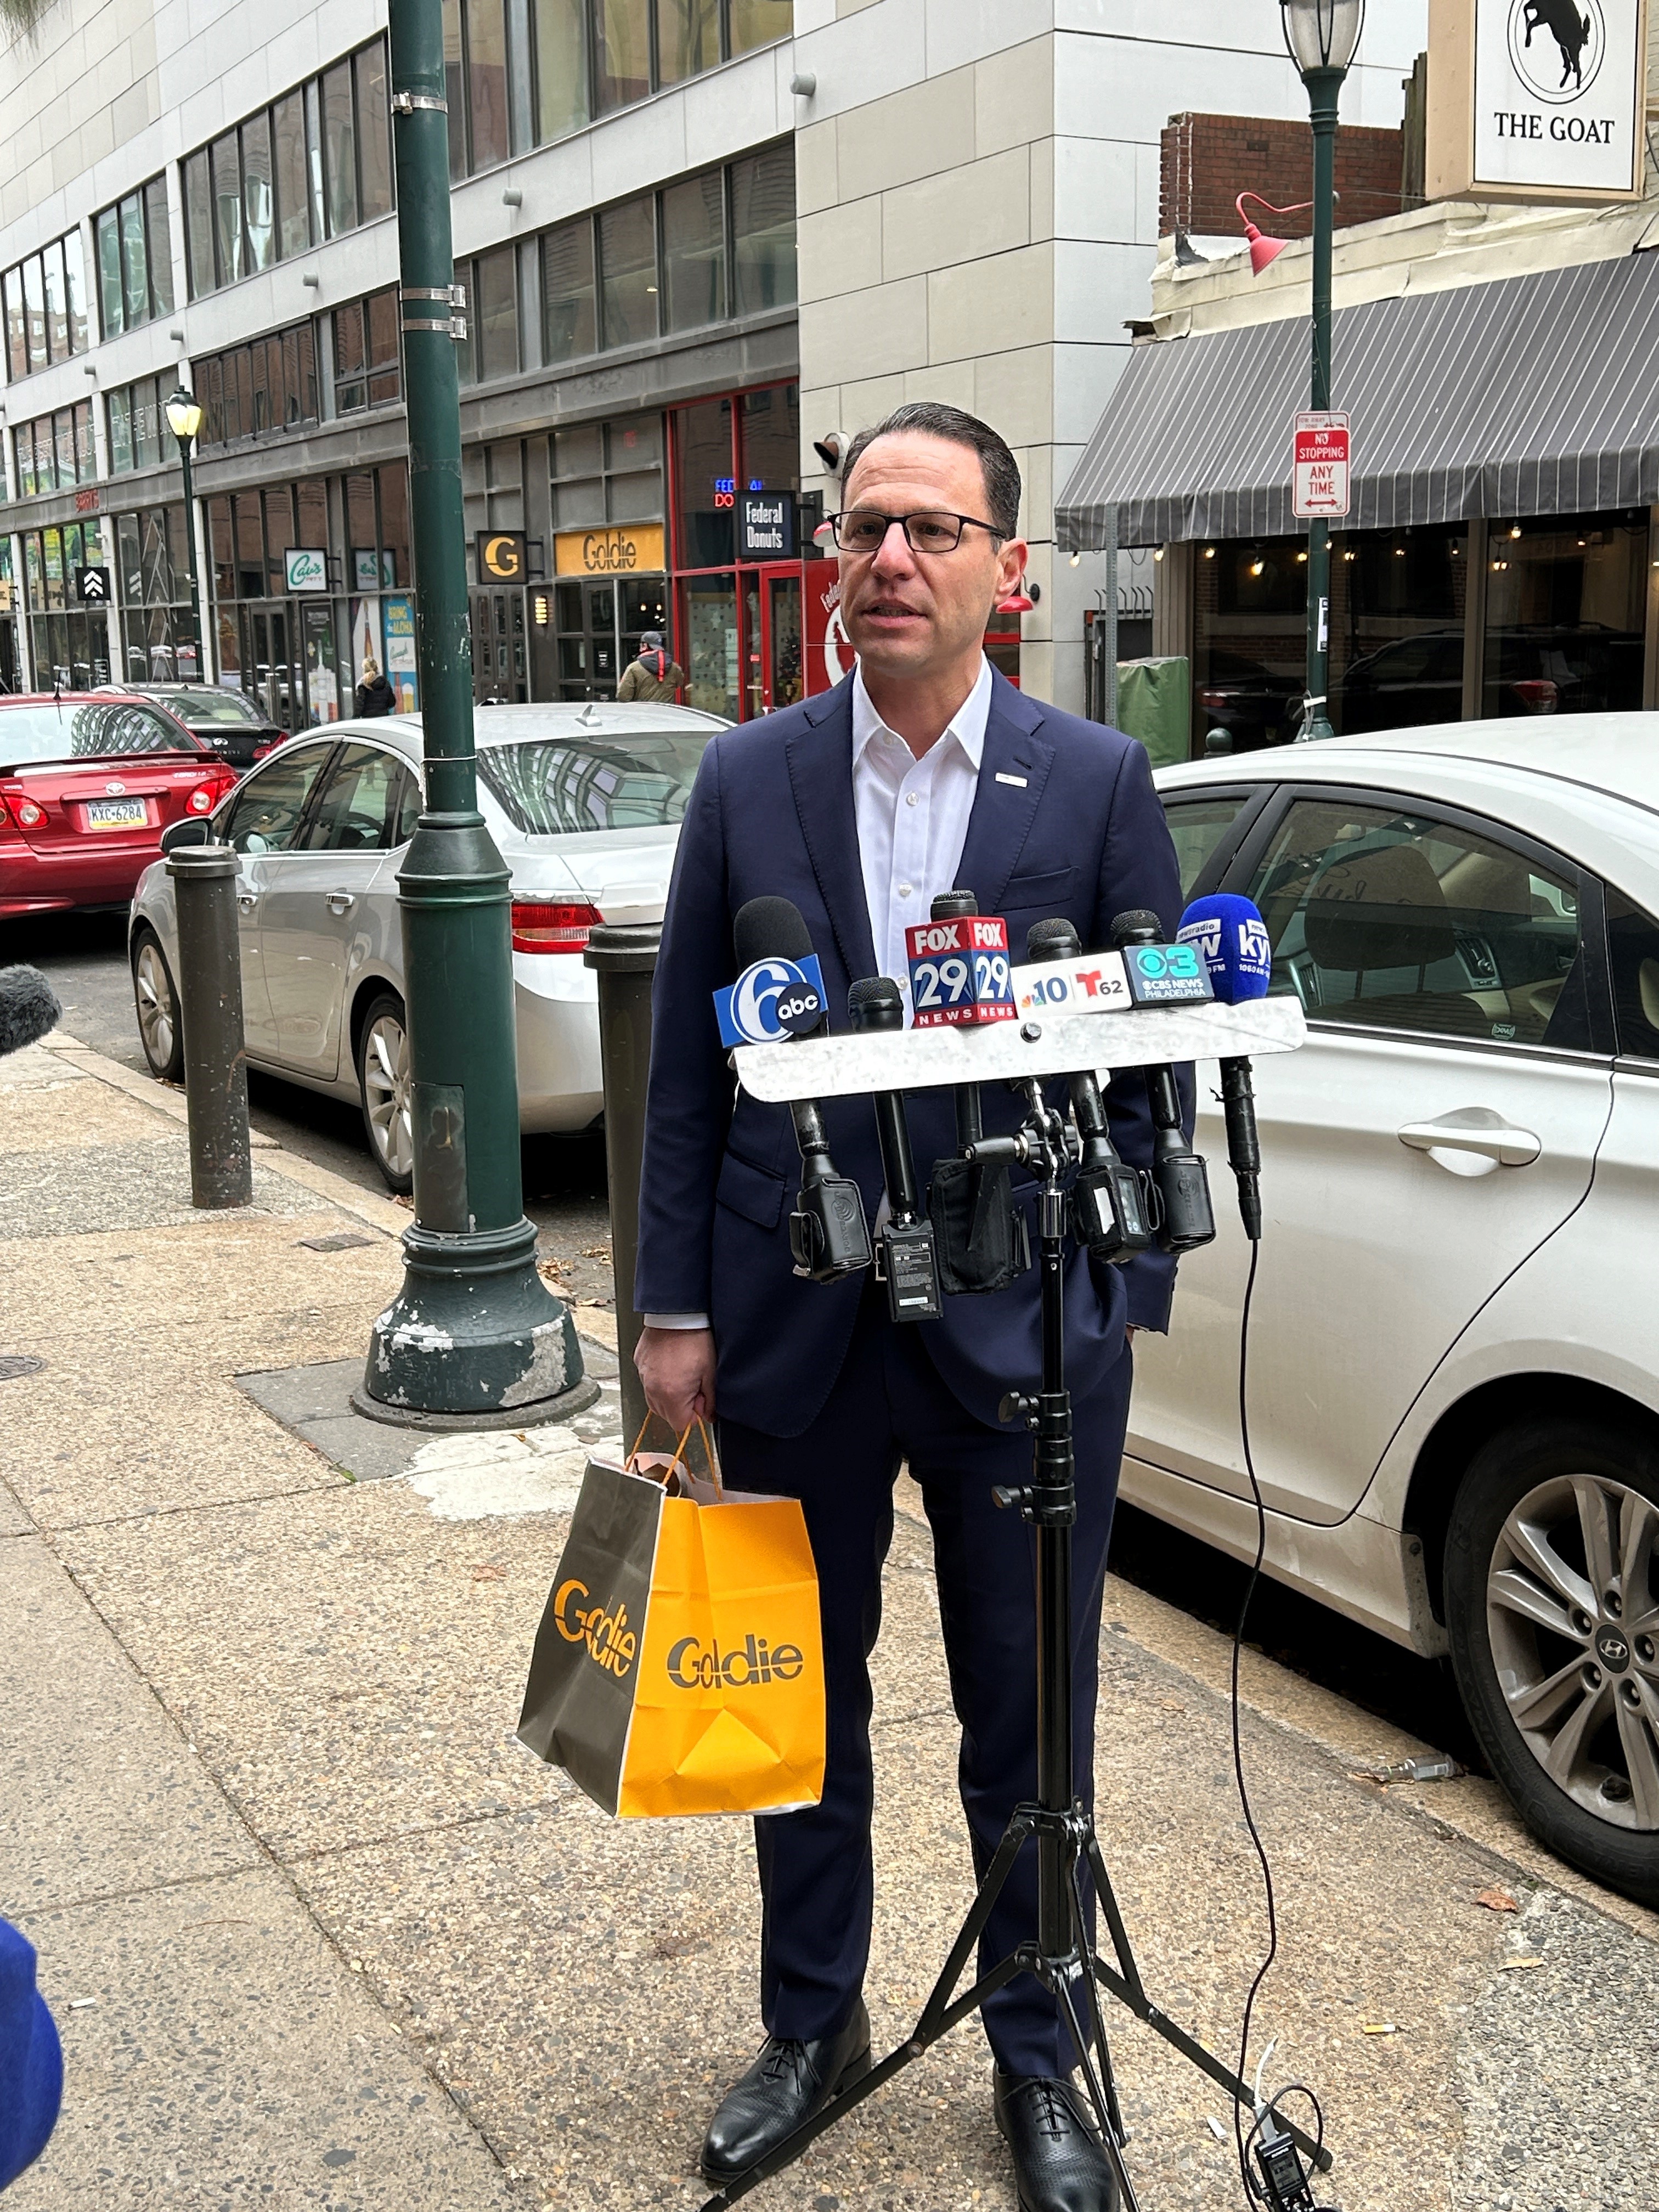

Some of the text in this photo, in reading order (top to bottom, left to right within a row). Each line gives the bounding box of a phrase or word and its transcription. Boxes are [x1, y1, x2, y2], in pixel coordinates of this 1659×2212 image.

[1494, 112, 1615, 144] THE GOAT
[1314, 432, 1329, 445] NO
[1299, 447, 1344, 460] STOPPING
[1310, 466, 1334, 479] ANY
[1308, 482, 1335, 495] TIME
[746, 501, 783, 523] Federal
[747, 526, 783, 548] Donuts
[485, 536, 518, 577] G
[583, 531, 636, 571] Goldie
[914, 924, 961, 956] FOX
[973, 922, 1003, 947] FOX
[914, 958, 968, 1007] 29
[976, 956, 1008, 999] 29
[1152, 978, 1204, 990] CBS NEWS
[738, 963, 789, 1041] 6
[1032, 977, 1068, 1005] 10
[1099, 980, 1123, 995] 62
[1144, 988, 1206, 999] PHILADELPHIA
[778, 995, 819, 1020] abc
[919, 1008, 973, 1025] NEWS
[980, 1006, 1013, 1018] NEWS
[667, 1634, 803, 1689] Goldie
